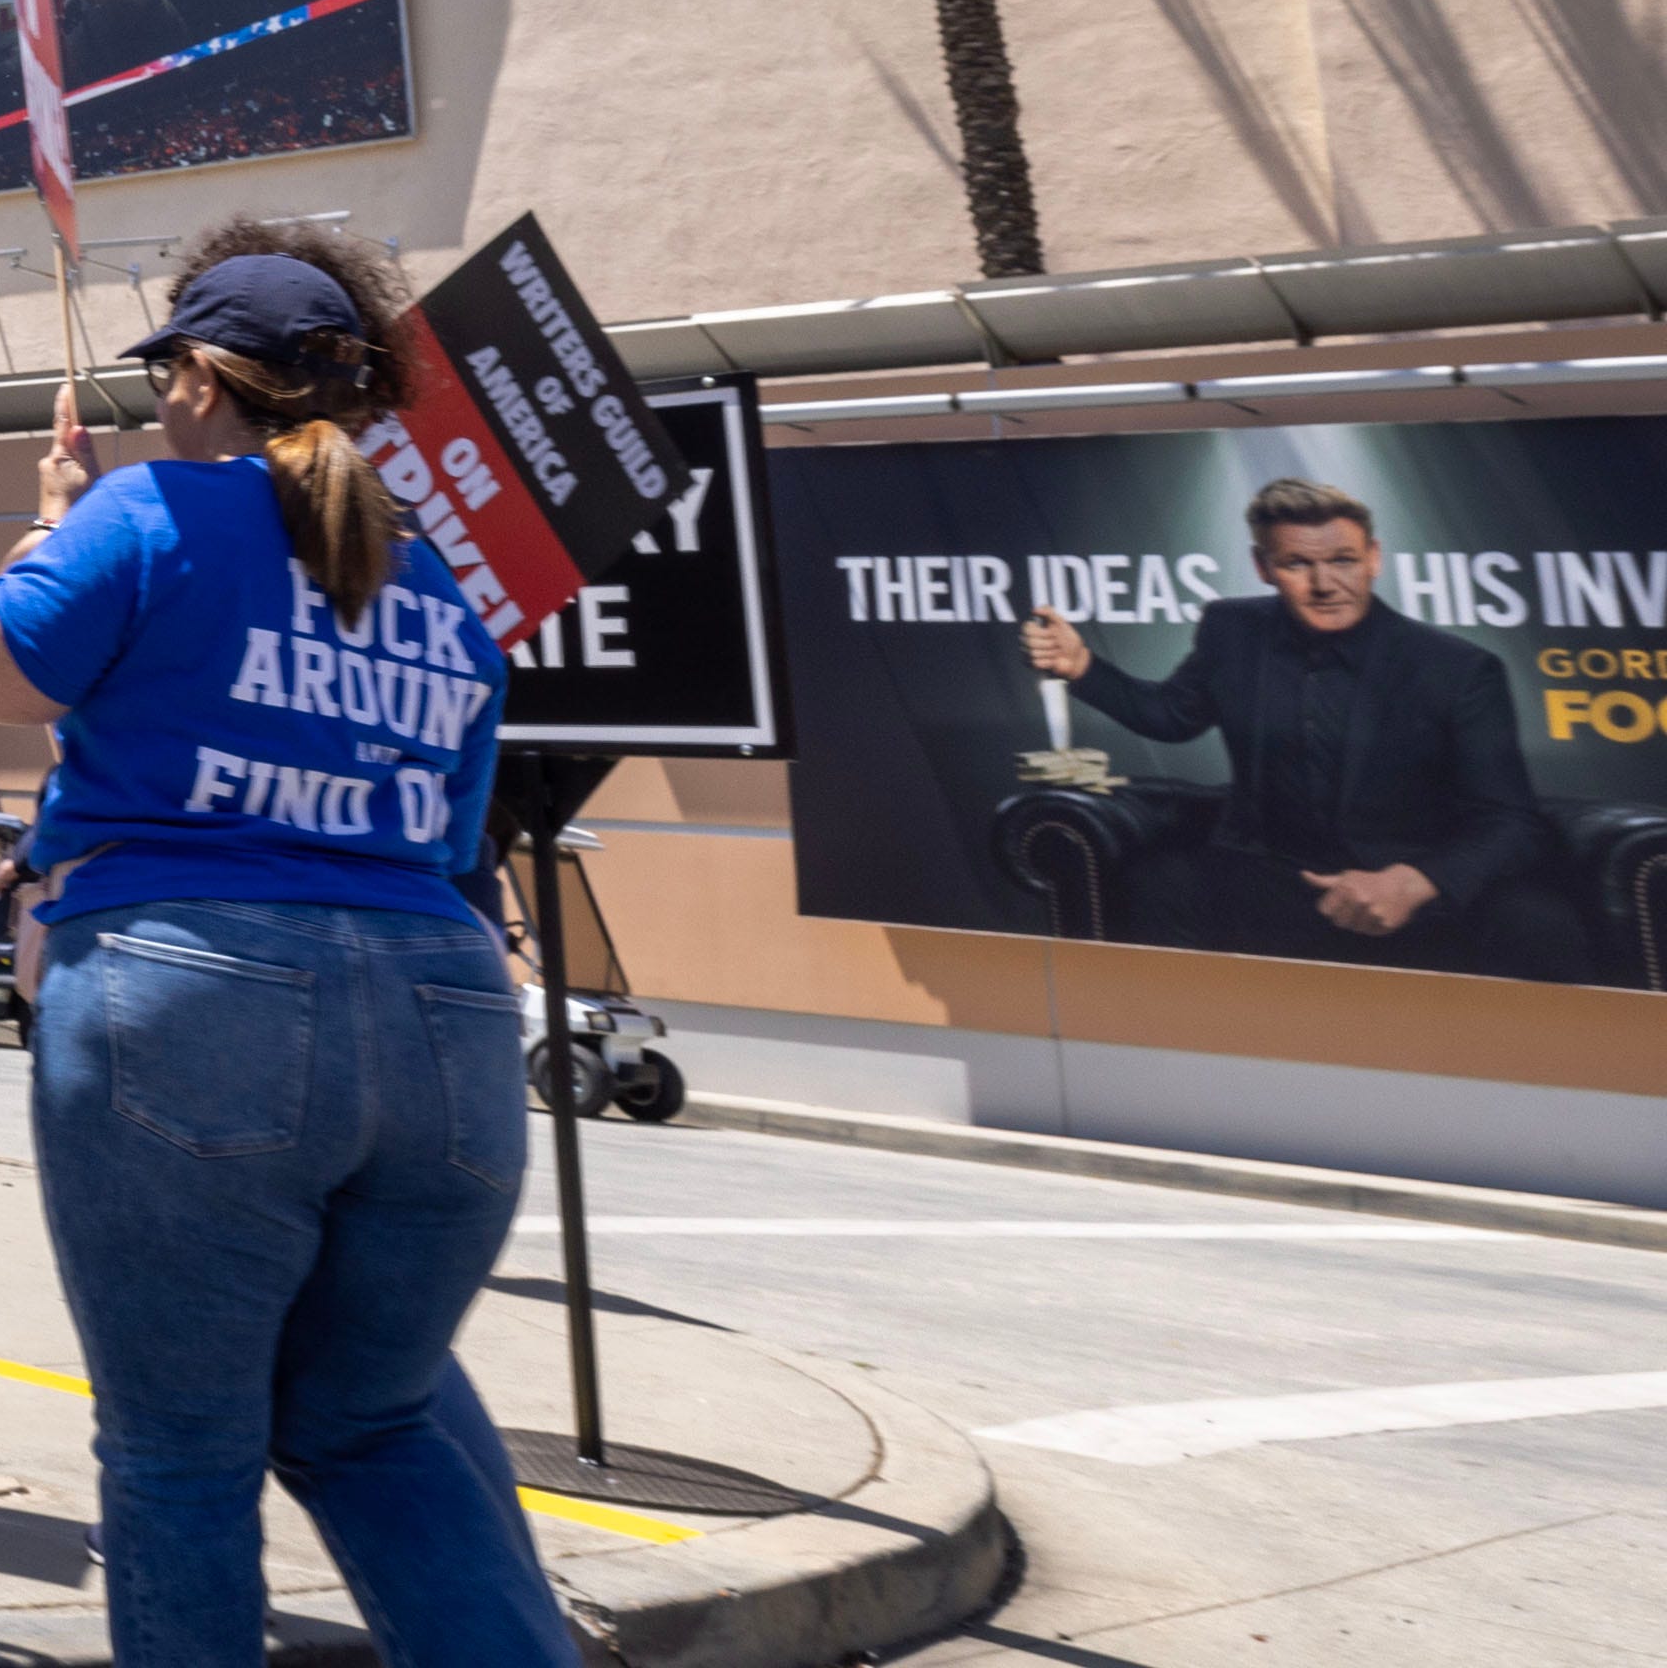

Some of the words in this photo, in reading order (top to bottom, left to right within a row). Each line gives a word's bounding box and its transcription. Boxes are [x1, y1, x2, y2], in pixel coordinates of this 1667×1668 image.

[500, 240, 609, 398] WRITERS
[590, 394, 667, 500] GUILD
[534, 375, 574, 416] OF
[465, 345, 579, 506] AMERICA
[439, 437, 503, 512] ON
[834, 554, 1018, 623] THEIR
[1026, 552, 1222, 624] IDEAS
[1394, 550, 1529, 628] HIS
[1532, 550, 1667, 629] INV
[1543, 688, 1667, 744] FO
[184, 745, 375, 836] FIND
